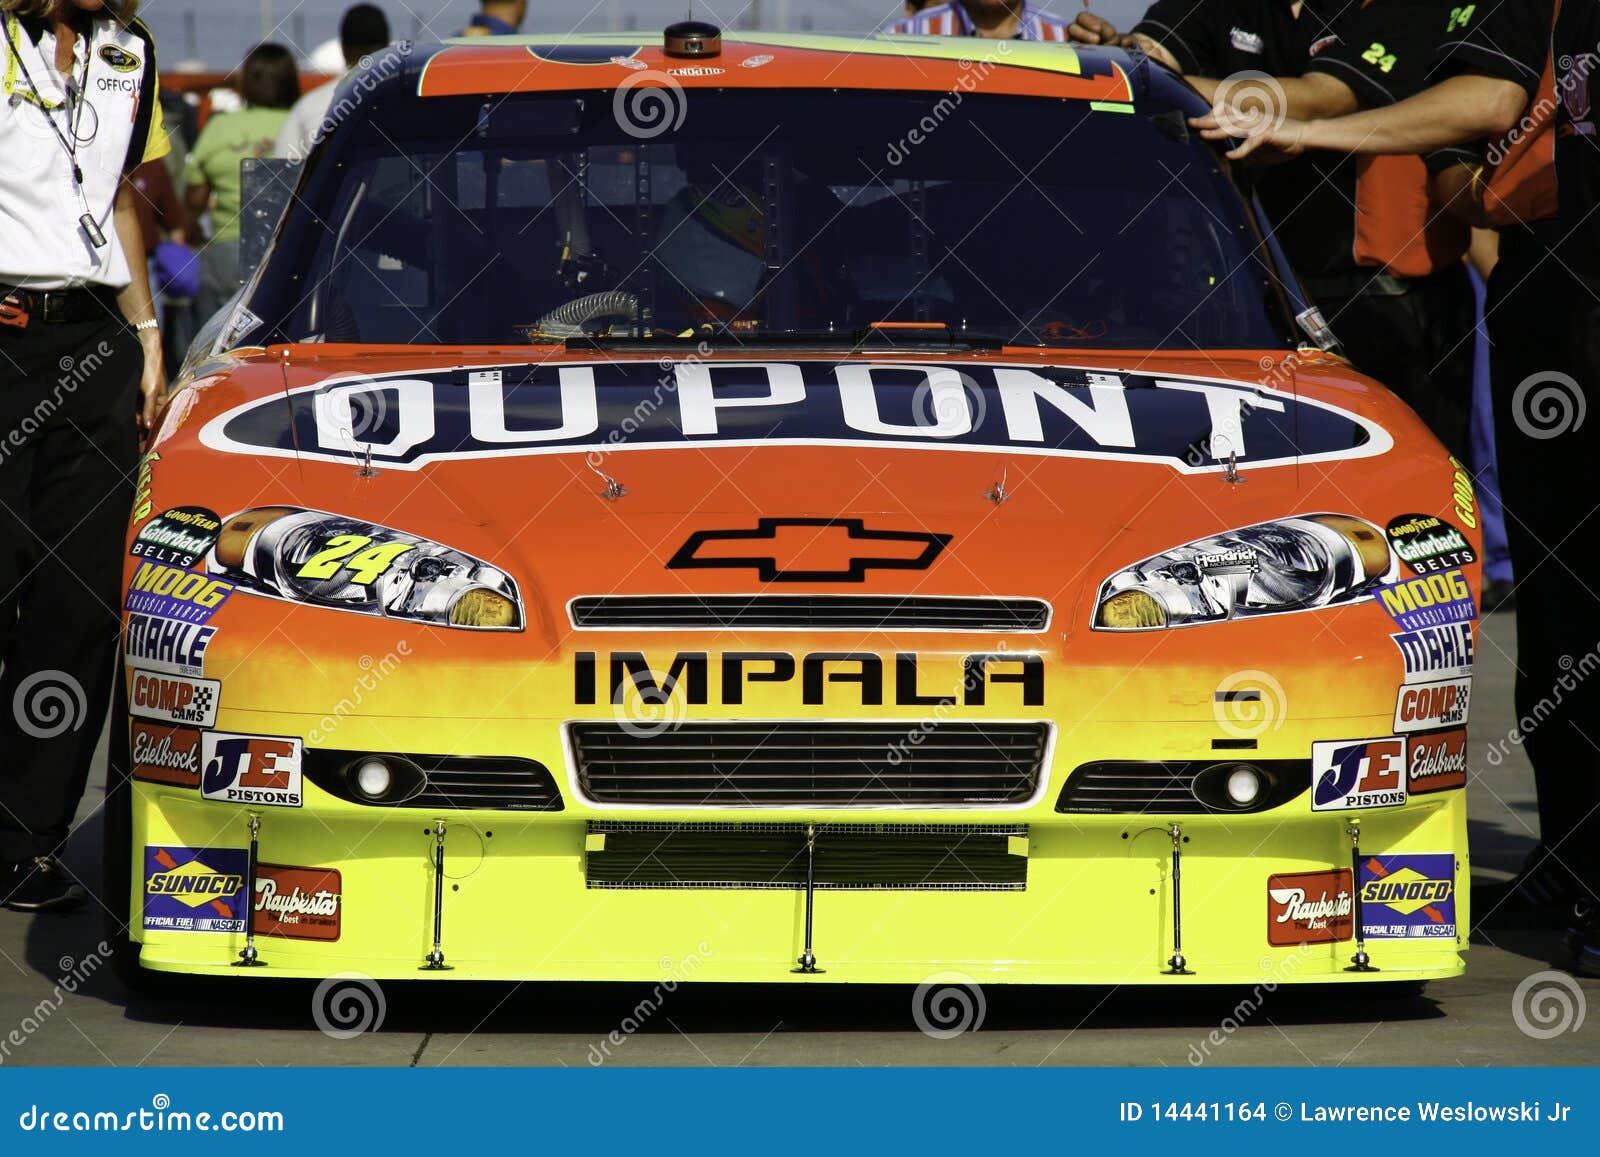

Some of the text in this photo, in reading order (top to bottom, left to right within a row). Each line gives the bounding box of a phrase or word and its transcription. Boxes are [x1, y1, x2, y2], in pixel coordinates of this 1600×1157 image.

[1447, 4, 1476, 33] 24
[1361, 42, 1397, 73] 24
[138, 518, 212, 552] Gatorback
[1393, 527, 1467, 560] Gatorback
[132, 543, 193, 567] BELTS
[295, 534, 418, 586] 24
[1194, 548, 1258, 567] Hendrick
[1413, 550, 1474, 574] BELTS
[129, 561, 234, 609] MOOG
[1380, 569, 1470, 618] MOOG
[1401, 607, 1446, 631] CHASSIS
[126, 613, 216, 668] MAHLE
[1392, 622, 1474, 673] MAHLE
[134, 675, 194, 712] COMP
[574, 651, 1046, 706] IMPALA
[171, 708, 205, 723] CAMS
[1400, 684, 1457, 722] COMP
[1440, 709, 1463, 724] CAMS
[133, 731, 199, 773] Edelbrock
[203, 738, 295, 795] JE
[1409, 742, 1466, 780] Edelbrock
[1314, 740, 1403, 806] JE
[227, 789, 300, 805] PISTONS
[1345, 791, 1405, 807] PISTONS
[149, 875, 239, 895] SUNOCO
[1363, 882, 1450, 902] SUNOCO
[176, 917, 194, 928] FUEL
[210, 919, 242, 931] NASCAR
[283, 914, 299, 925] best
[1313, 919, 1327, 929] best
[1390, 925, 1407, 935] FUEL
[1423, 925, 1455, 936] NASCAR
